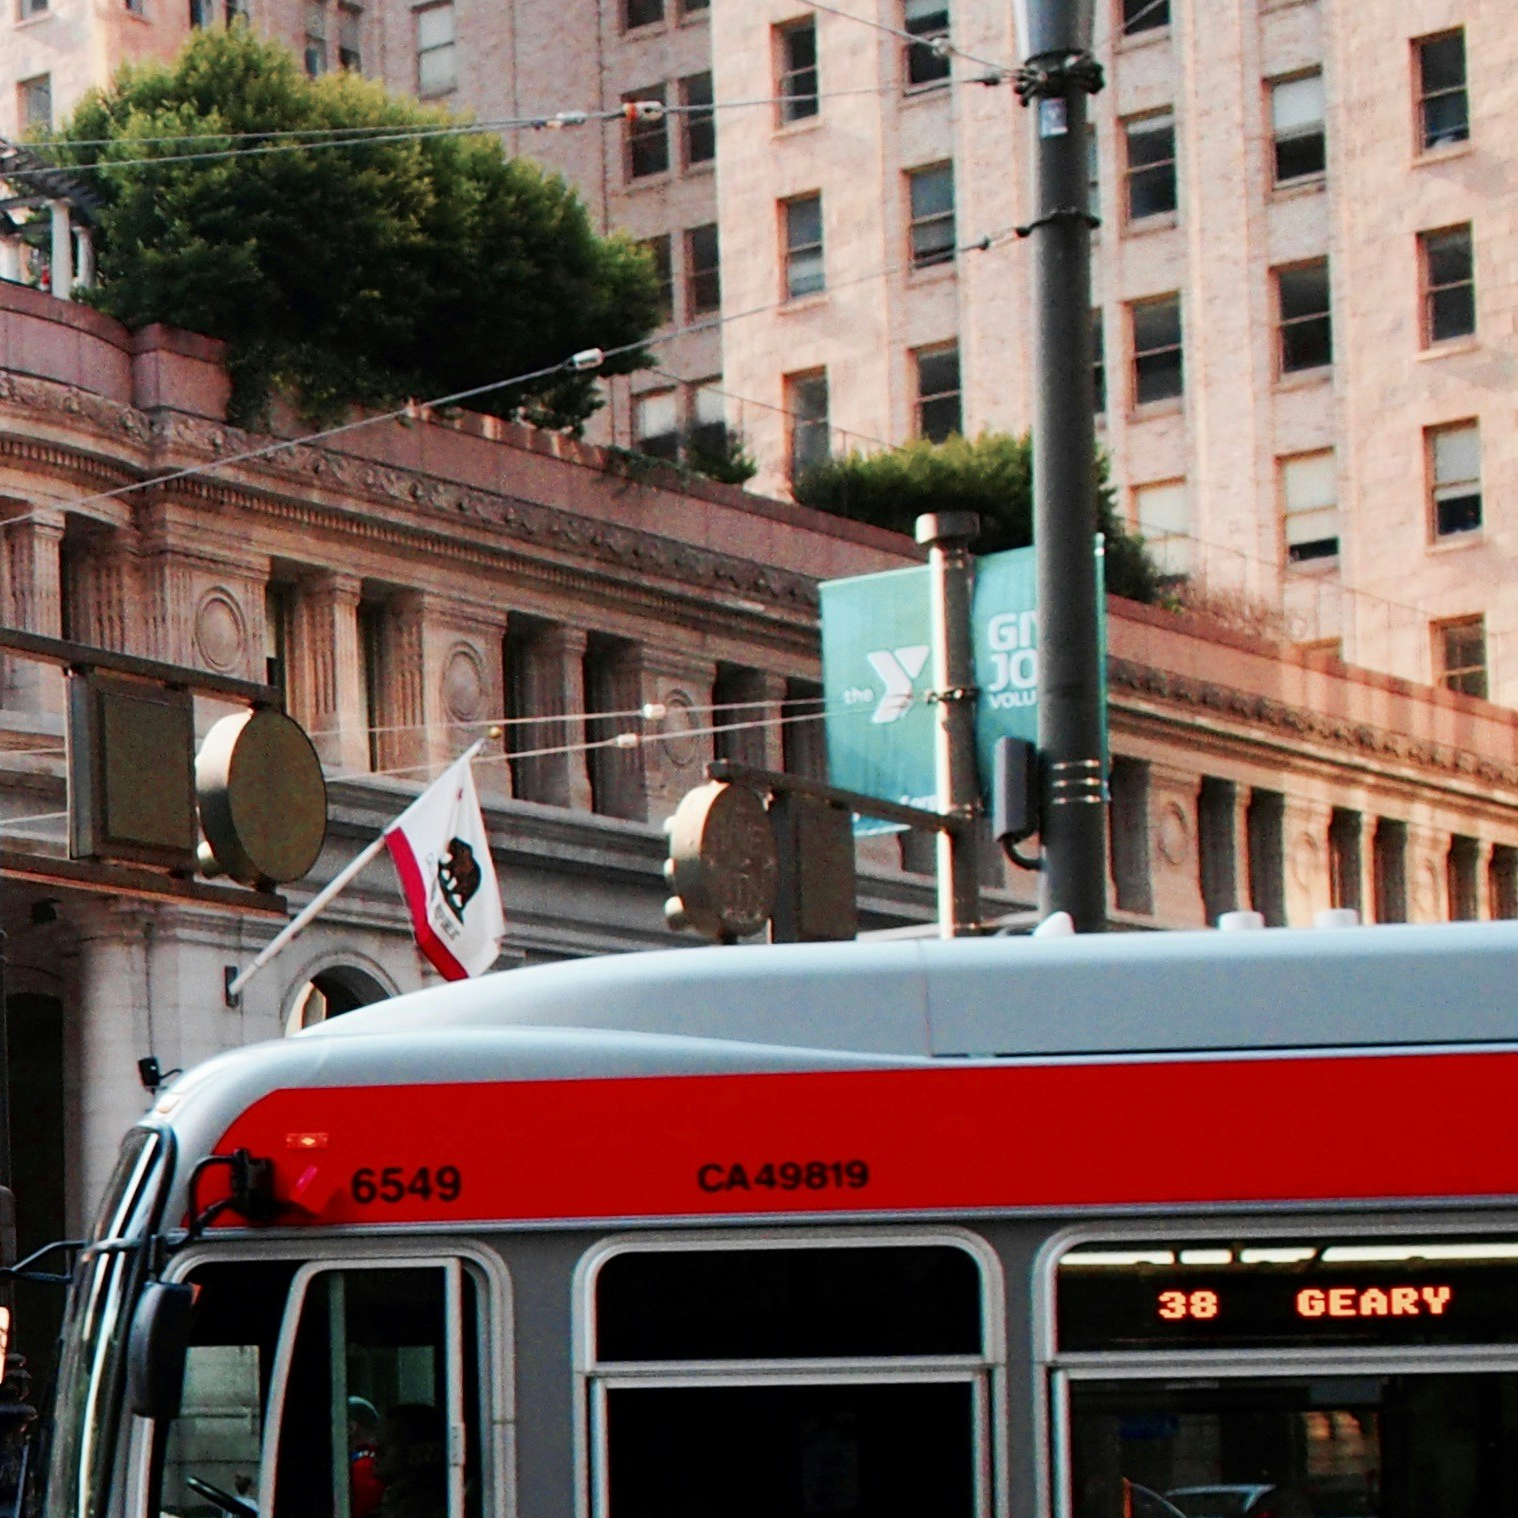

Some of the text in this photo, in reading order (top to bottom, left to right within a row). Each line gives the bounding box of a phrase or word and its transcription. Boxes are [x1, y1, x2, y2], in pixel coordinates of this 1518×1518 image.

[988, 650, 1039, 692] JO
[844, 687, 874, 704] the
[351, 1165, 462, 1204] 6549
[697, 1159, 869, 1193] CA49819
[1158, 1286, 1451, 1319] 38 GEARY
